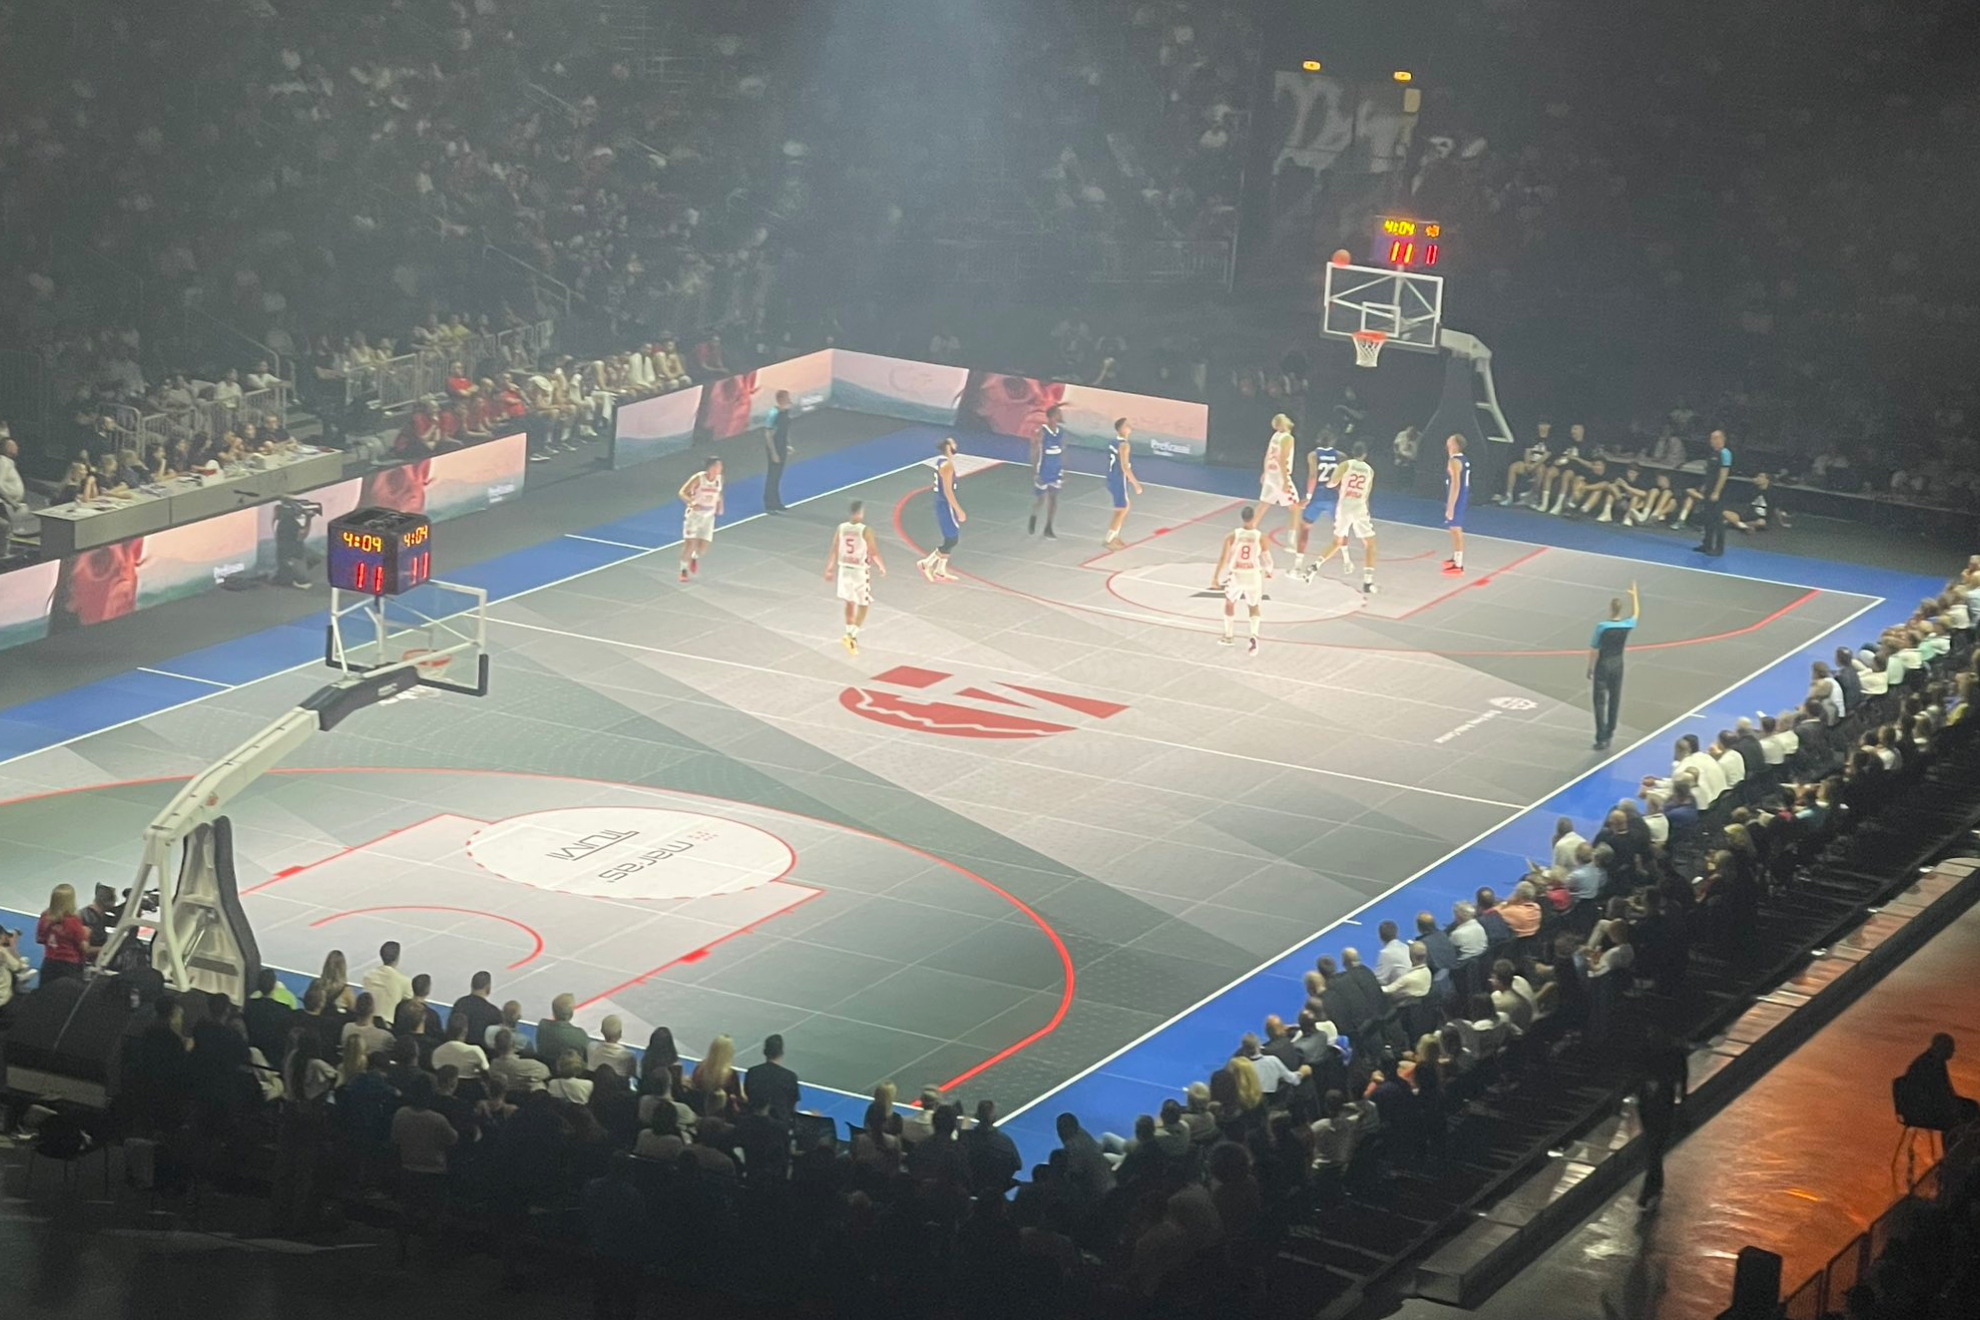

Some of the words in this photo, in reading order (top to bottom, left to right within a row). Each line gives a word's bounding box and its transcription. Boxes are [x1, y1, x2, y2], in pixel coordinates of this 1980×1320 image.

[1348, 473, 1366, 490] 22
[845, 538, 855, 555] 5
[1241, 545, 1251, 560] 8
[544, 829, 640, 861] TUMI
